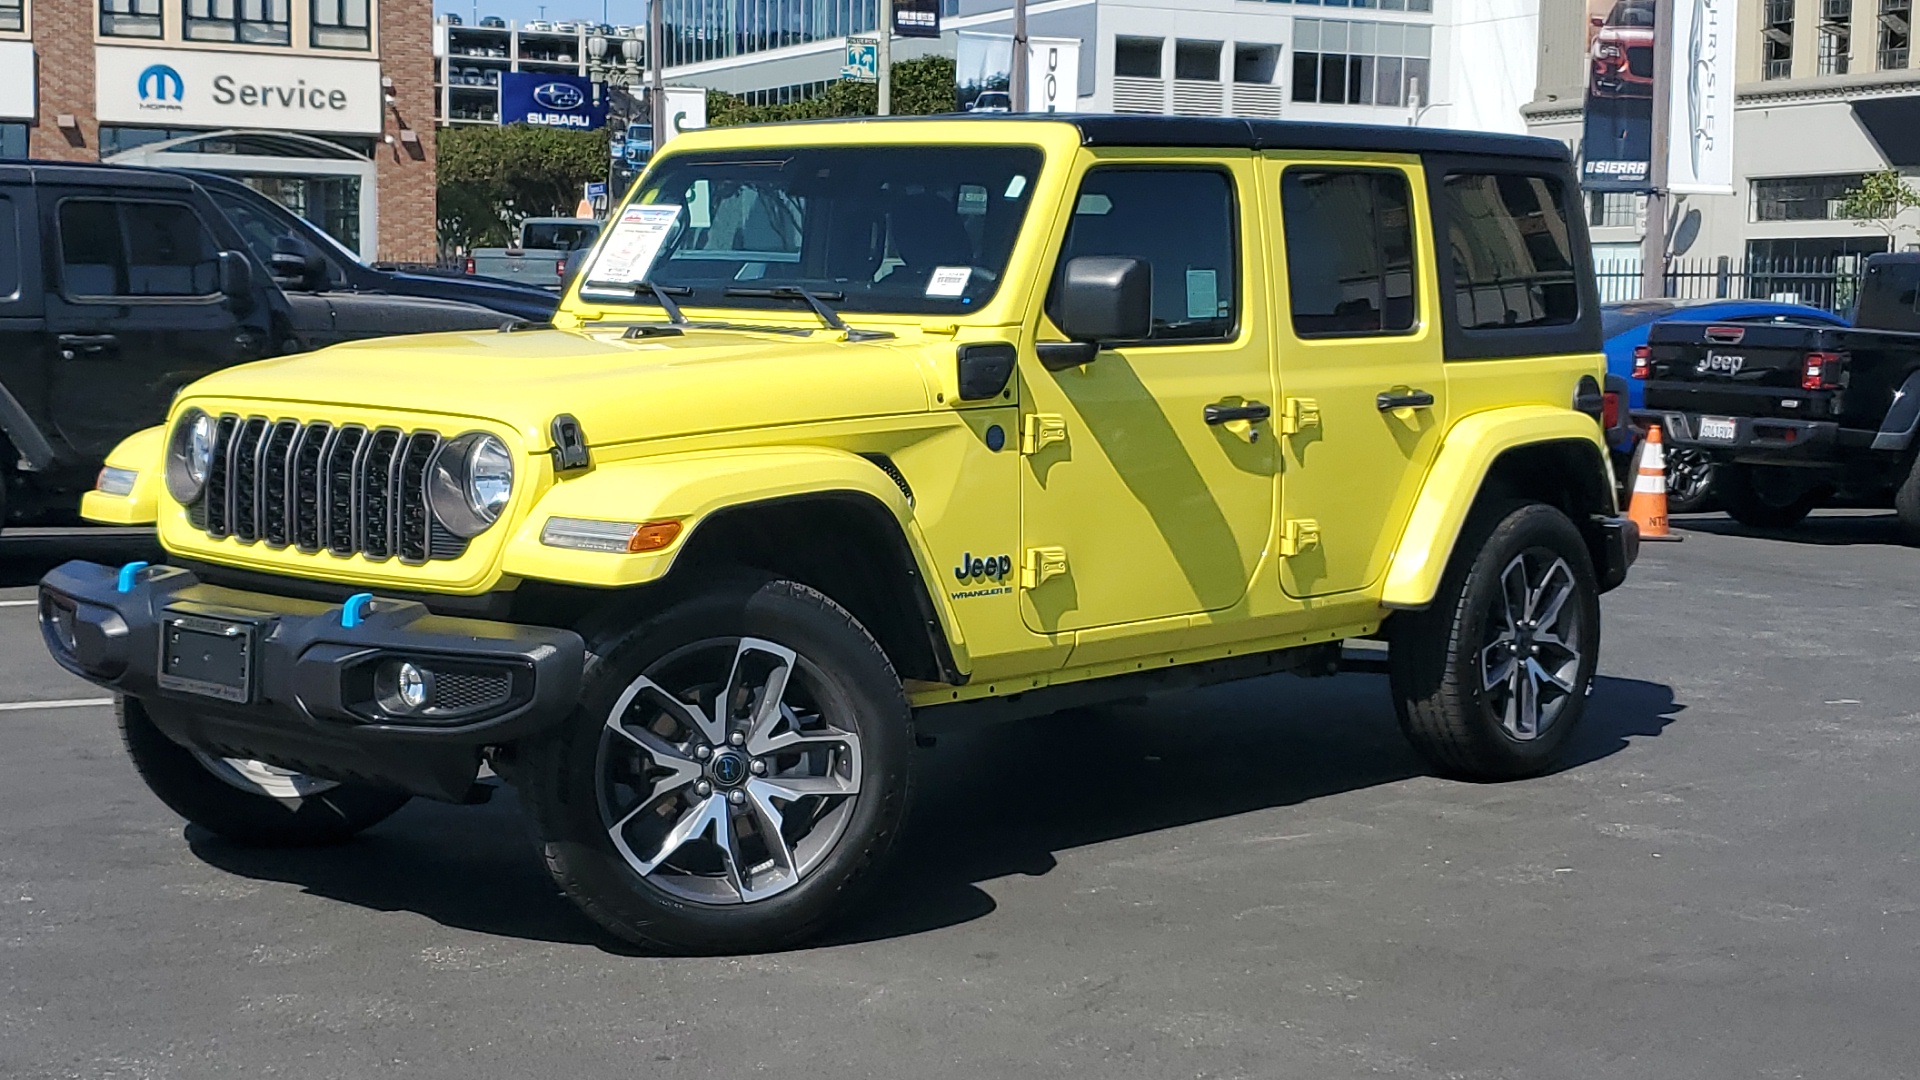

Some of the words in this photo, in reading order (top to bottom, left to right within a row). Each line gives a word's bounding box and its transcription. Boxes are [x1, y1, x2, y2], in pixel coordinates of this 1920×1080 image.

[1046, 47, 1058, 113] DO
[1704, 0, 1718, 152] HRYSLER
[212, 74, 347, 111] Service
[527, 113, 590, 127] SUBARU
[1595, 161, 1647, 174] SIERRA
[1698, 350, 1743, 374] Jeep
[954, 552, 1011, 580] Jeep
[951, 588, 1003, 599] WRANGLER
